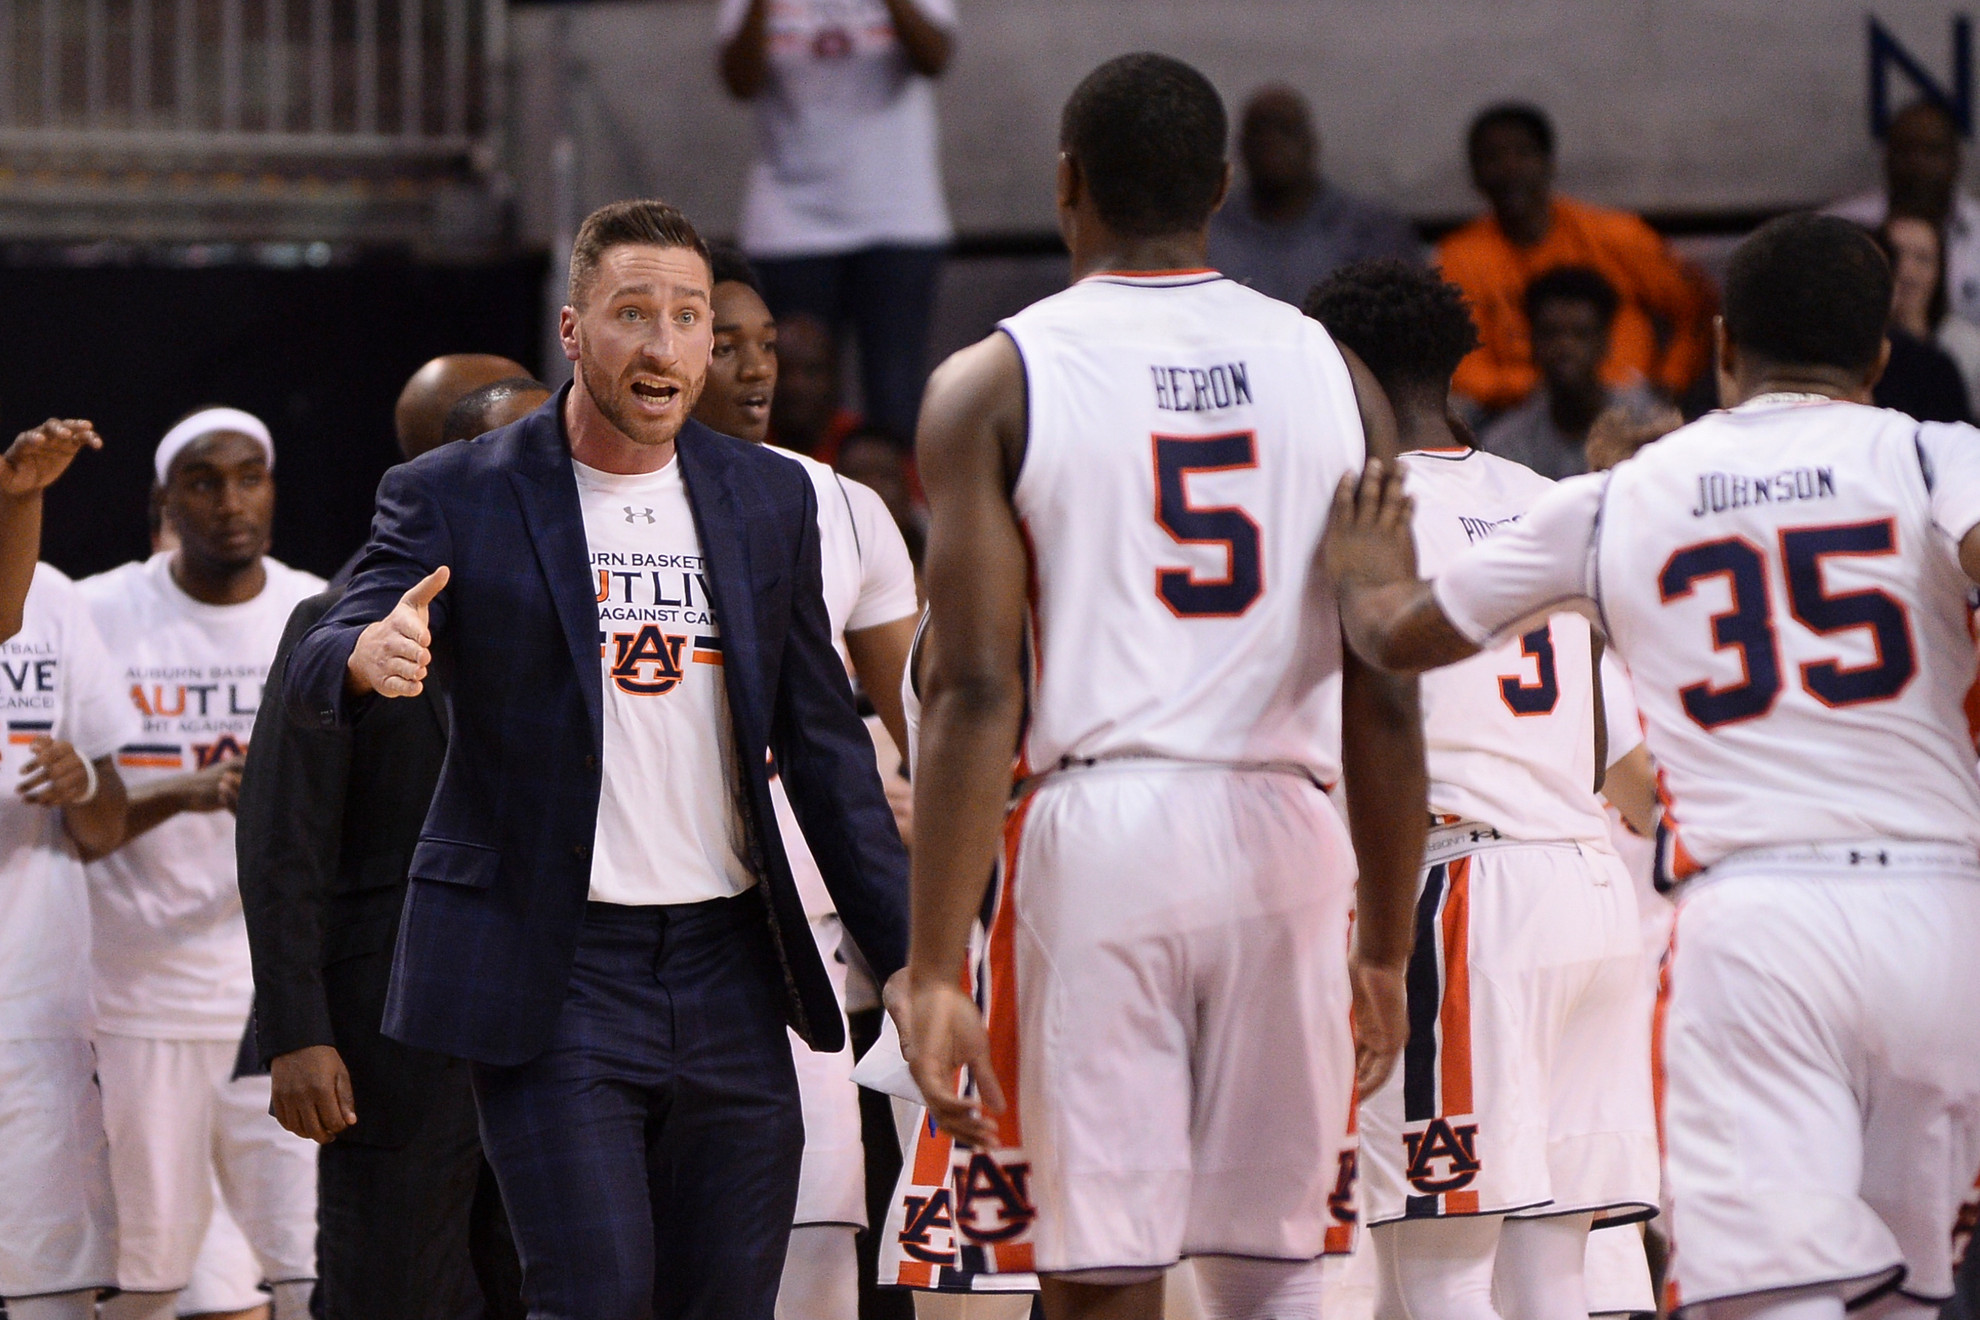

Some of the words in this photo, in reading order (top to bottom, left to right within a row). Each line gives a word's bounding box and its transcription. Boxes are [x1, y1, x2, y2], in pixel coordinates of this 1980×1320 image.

[1150, 361, 1254, 412] HERON
[1692, 464, 1836, 518] JOHNSON
[1150, 428, 1266, 619] 5
[632, 553, 704, 570] BASKET
[600, 607, 679, 622] AGAINST
[1658, 514, 1920, 733] 35
